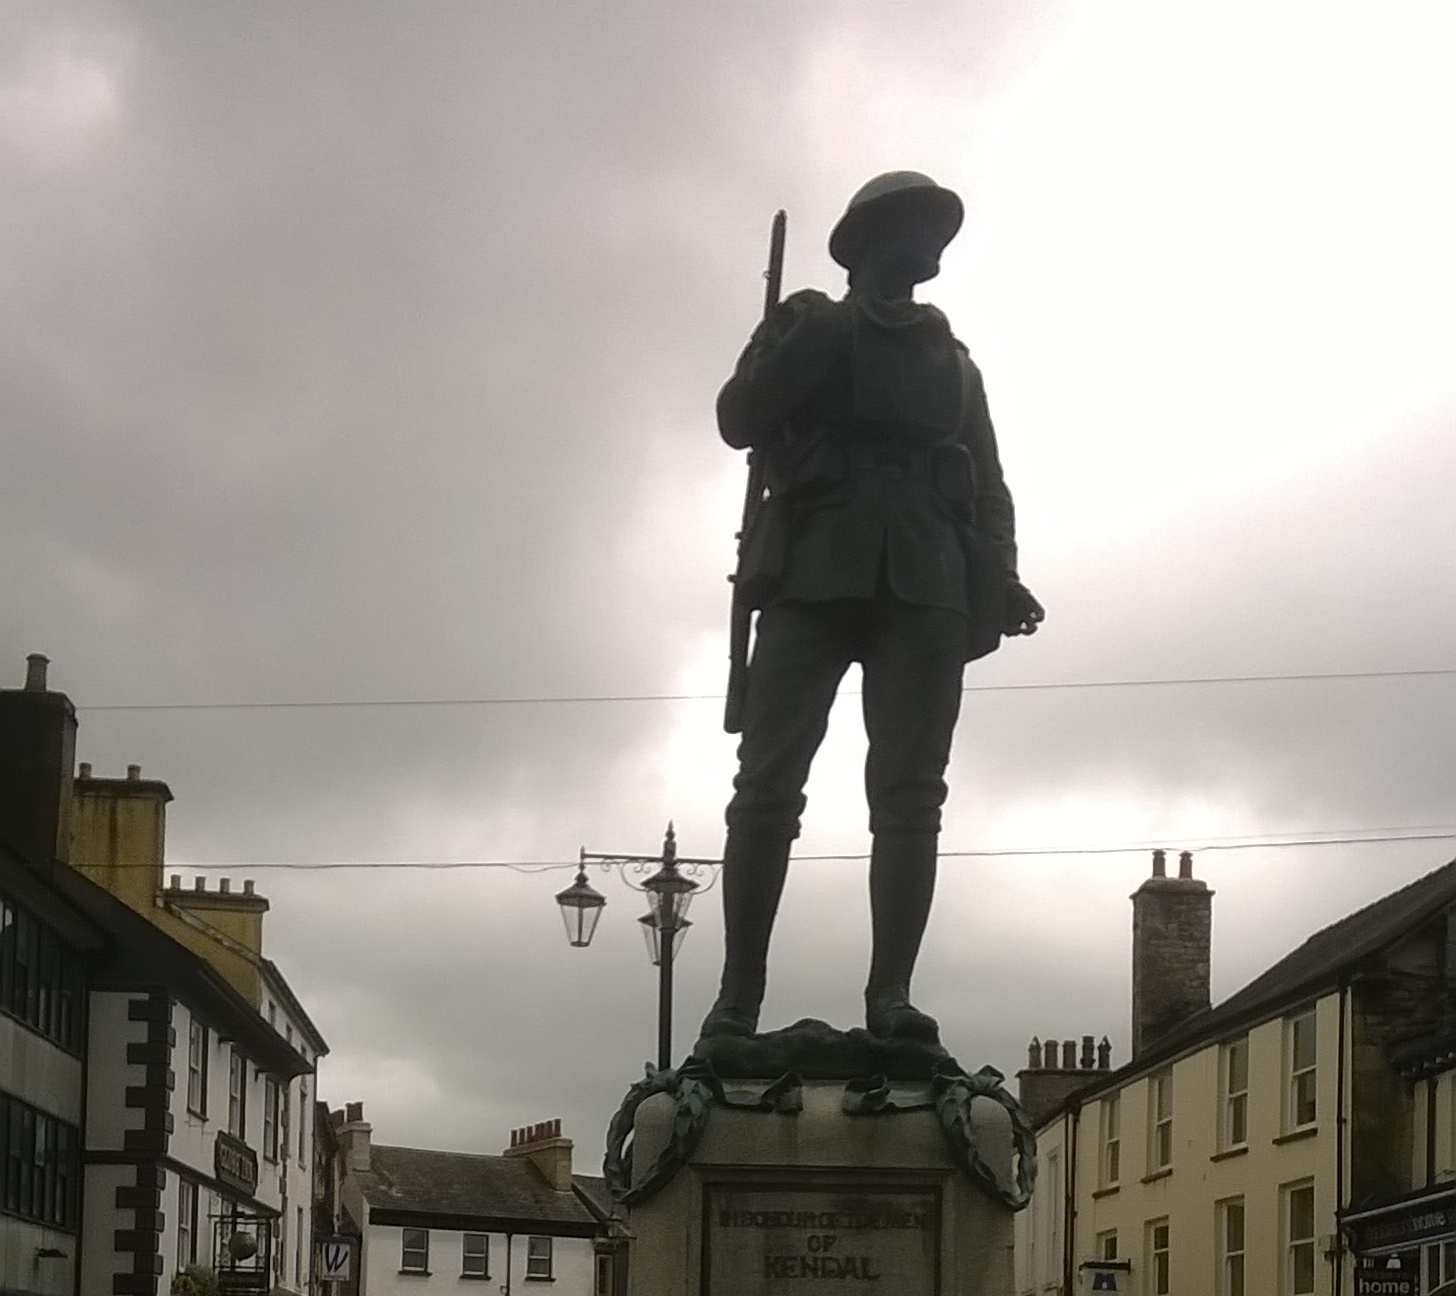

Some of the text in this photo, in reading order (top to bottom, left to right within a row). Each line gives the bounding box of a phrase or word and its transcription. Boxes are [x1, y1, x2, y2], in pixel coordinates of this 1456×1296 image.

[807, 1235, 837, 1252] OF
[764, 1255, 880, 1280] KENDAL
[1358, 1277, 1411, 1293] home
